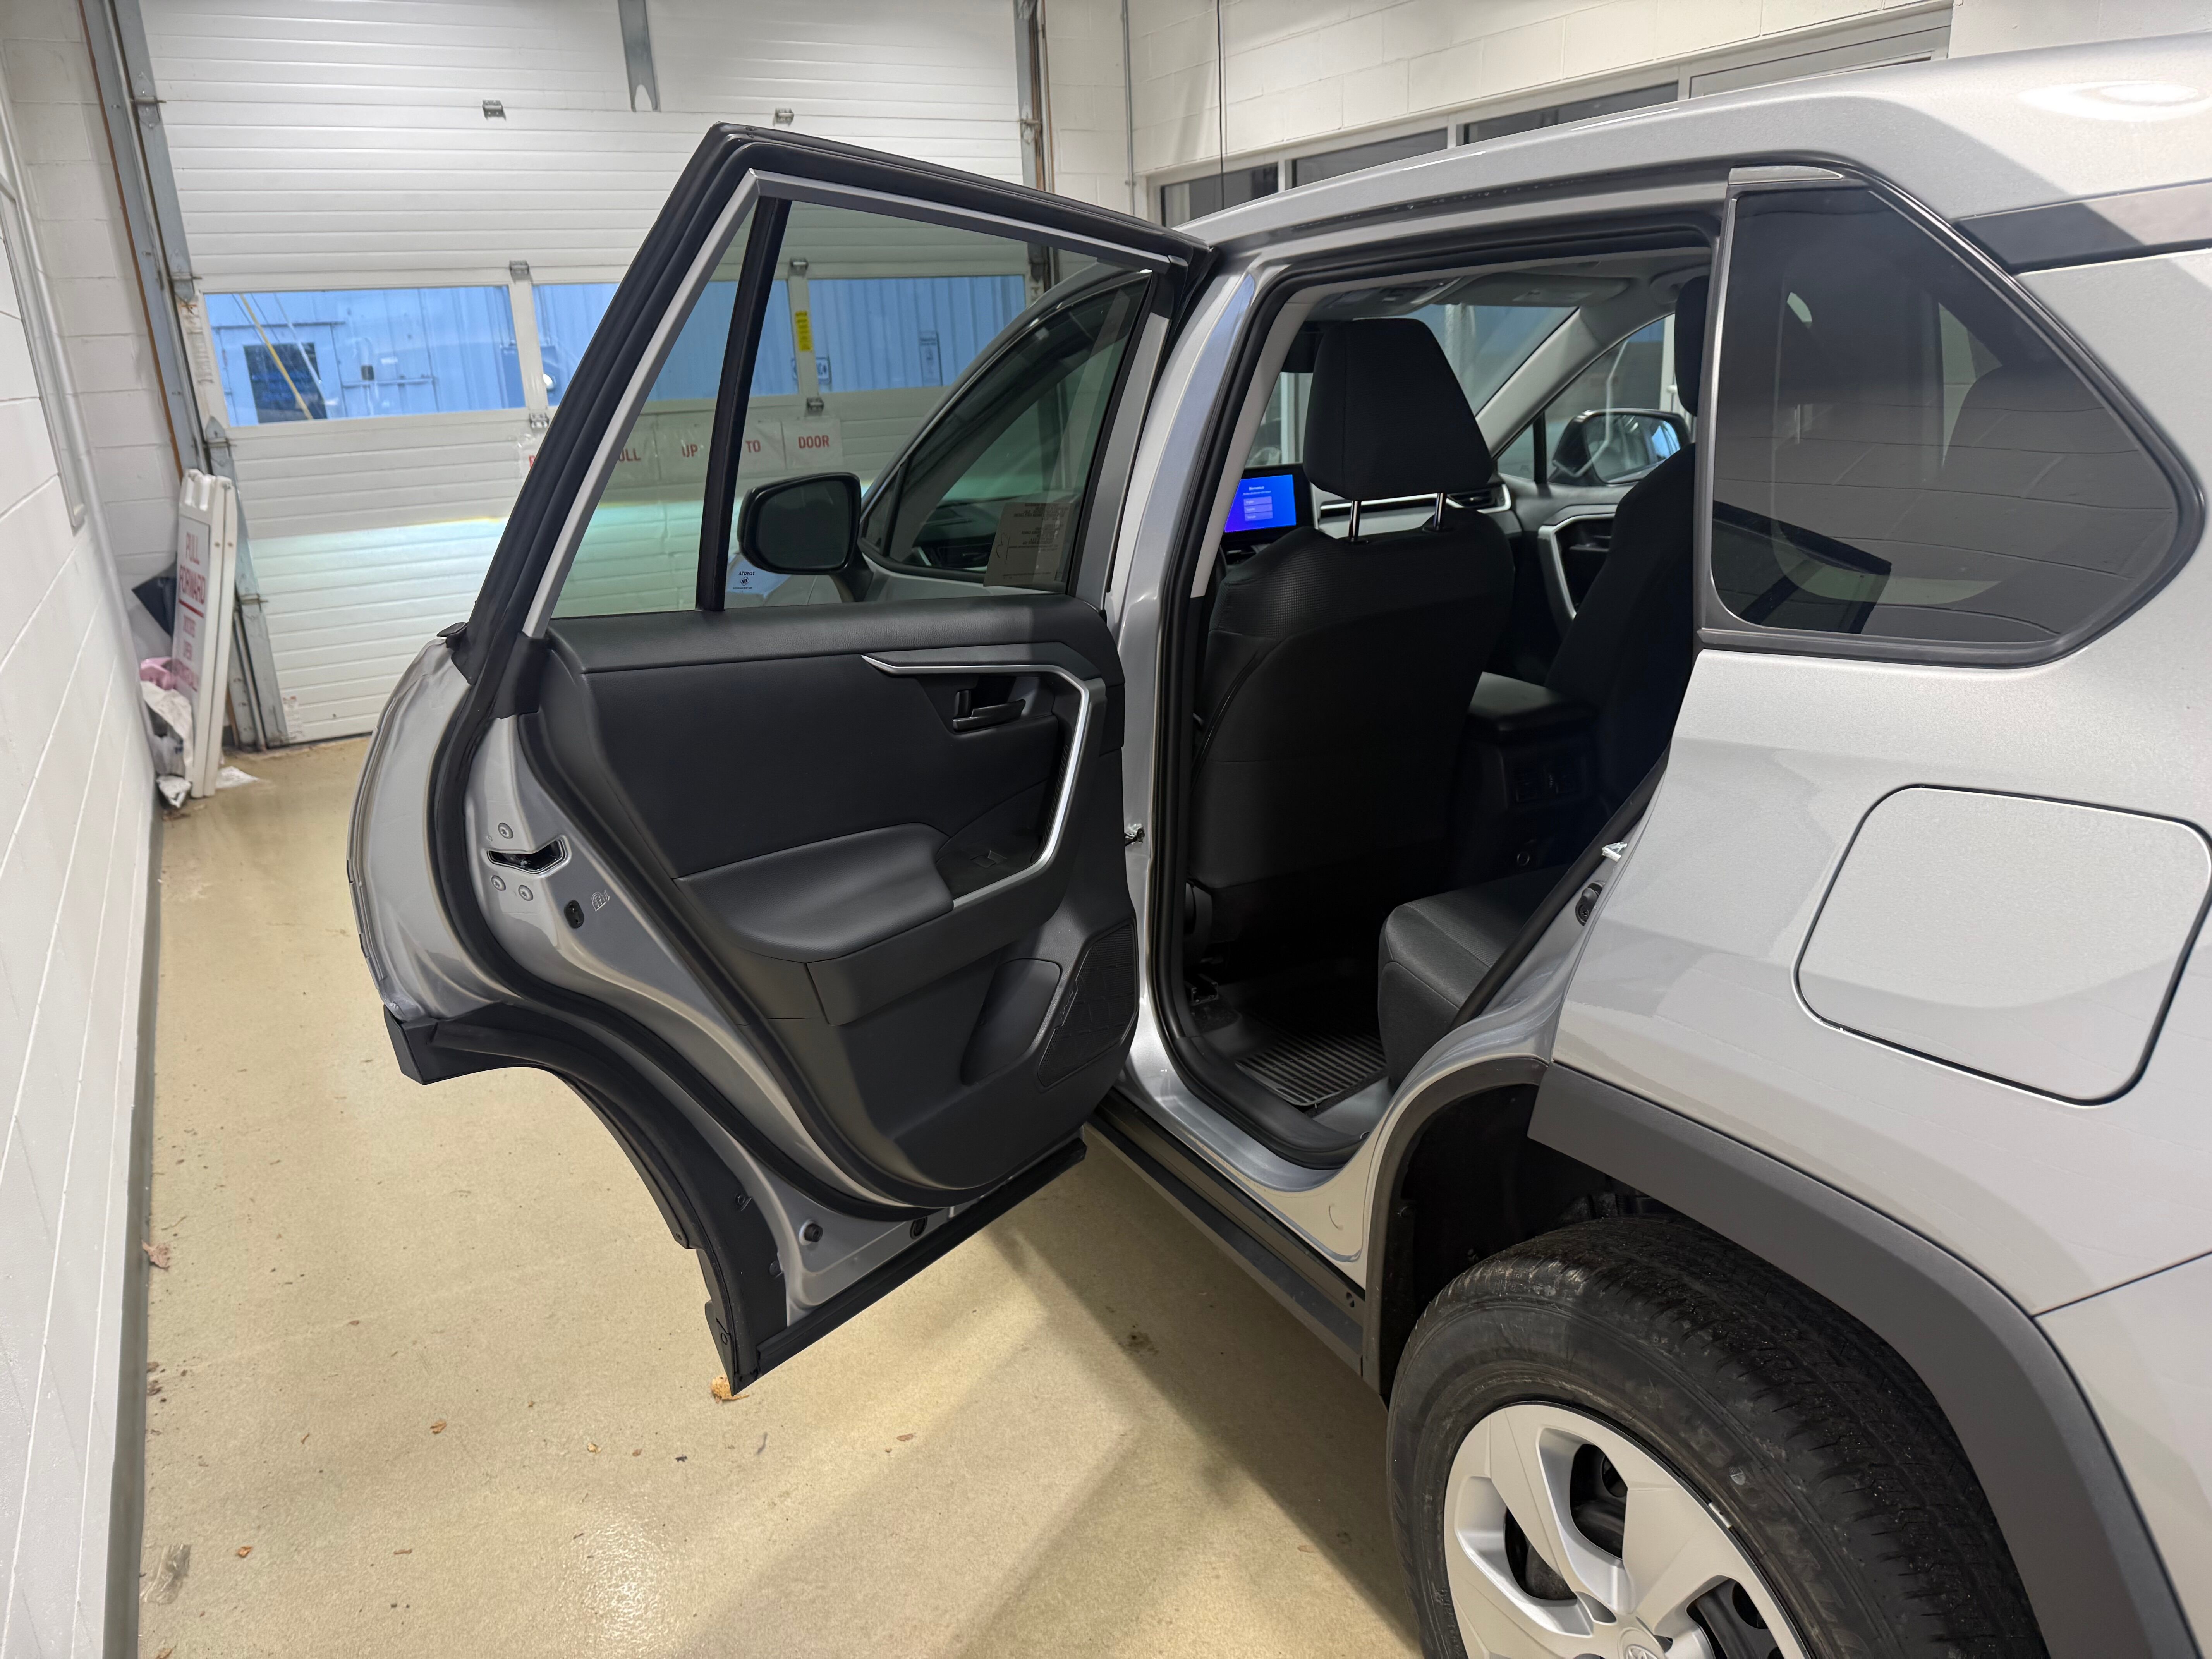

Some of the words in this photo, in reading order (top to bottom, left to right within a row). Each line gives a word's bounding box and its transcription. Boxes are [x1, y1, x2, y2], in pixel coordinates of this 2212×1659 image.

[682, 444, 698, 458] UP
[746, 440, 761, 453] TO
[798, 435, 830, 448] DOOR
[185, 532, 200, 565] PULL
[179, 564, 206, 605] FORWARD
